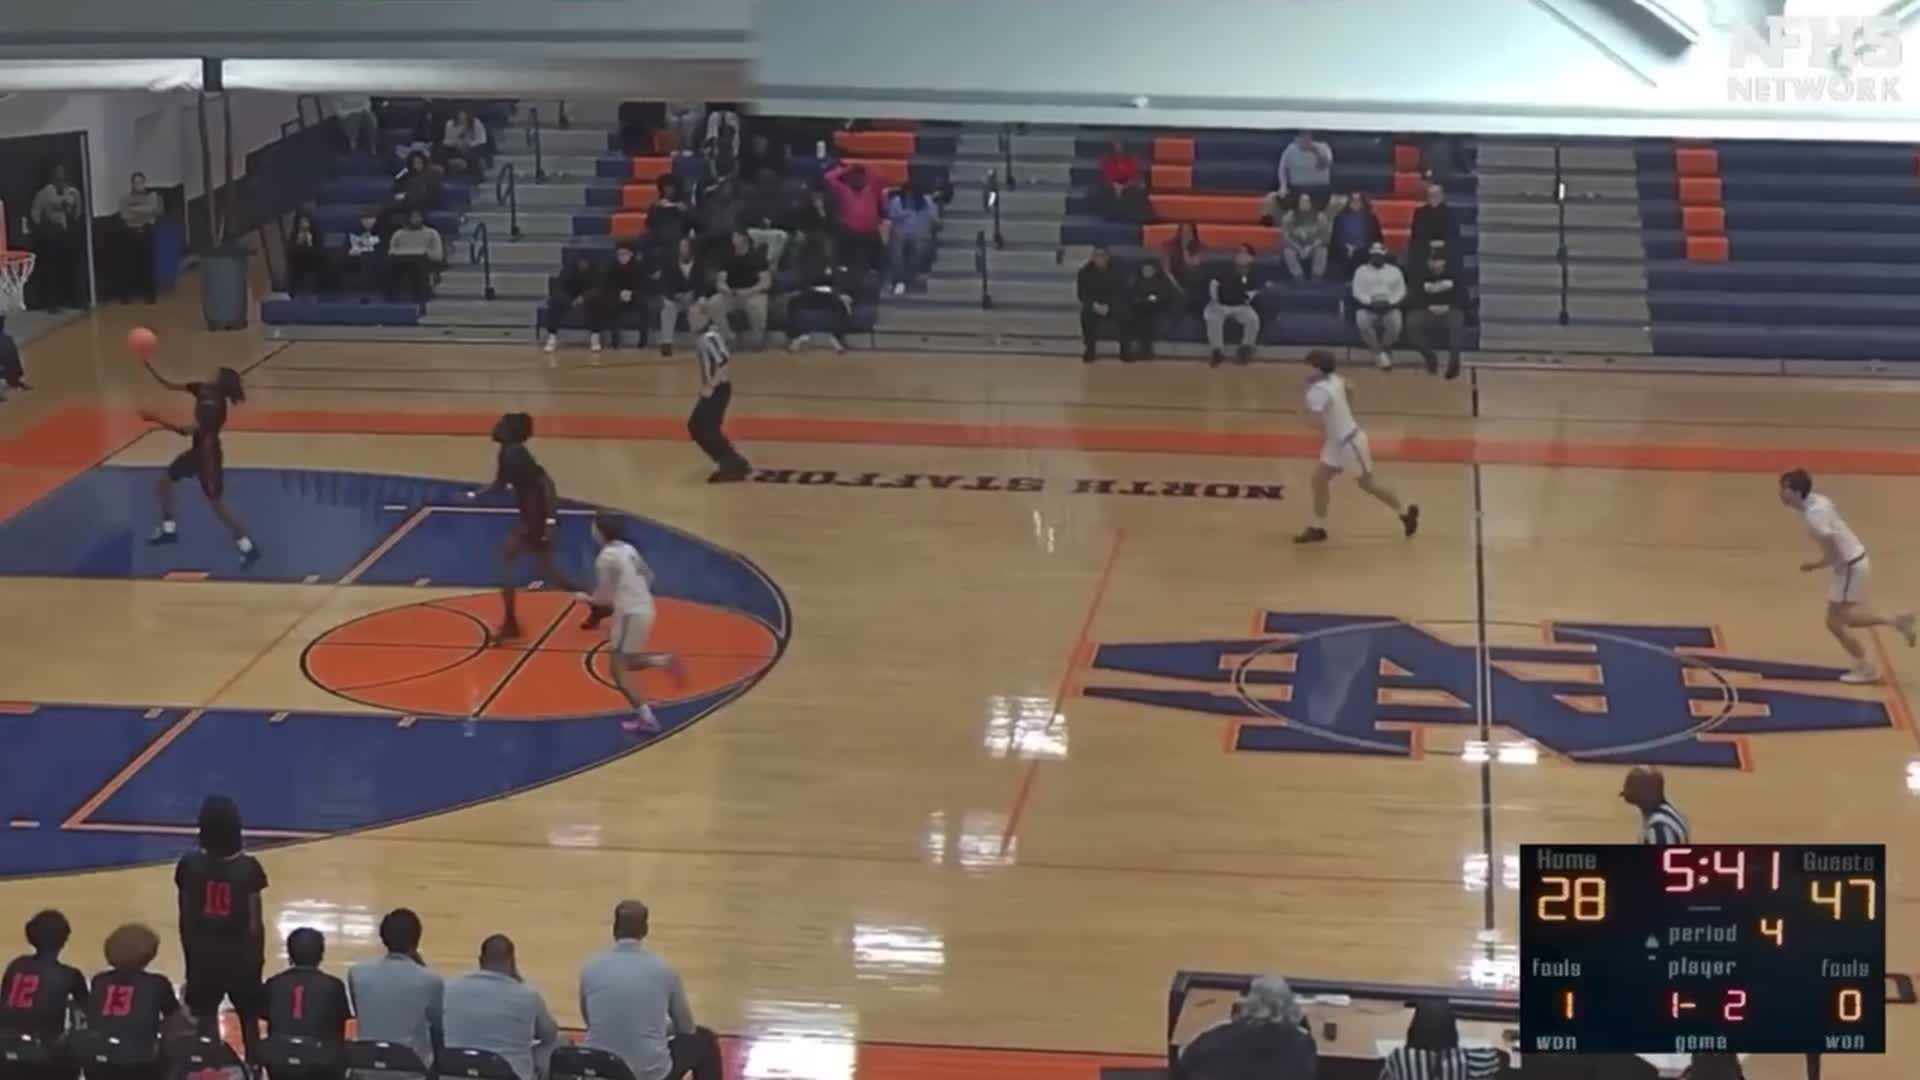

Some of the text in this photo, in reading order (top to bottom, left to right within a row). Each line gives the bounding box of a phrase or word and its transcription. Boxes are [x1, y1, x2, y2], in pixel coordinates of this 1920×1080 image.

[745, 469, 1285, 500] NORTH STAFFOR
[204, 881, 232, 917] 10
[8, 973, 40, 1008] 12
[102, 984, 135, 1017] 13
[290, 985, 305, 1020] 1
